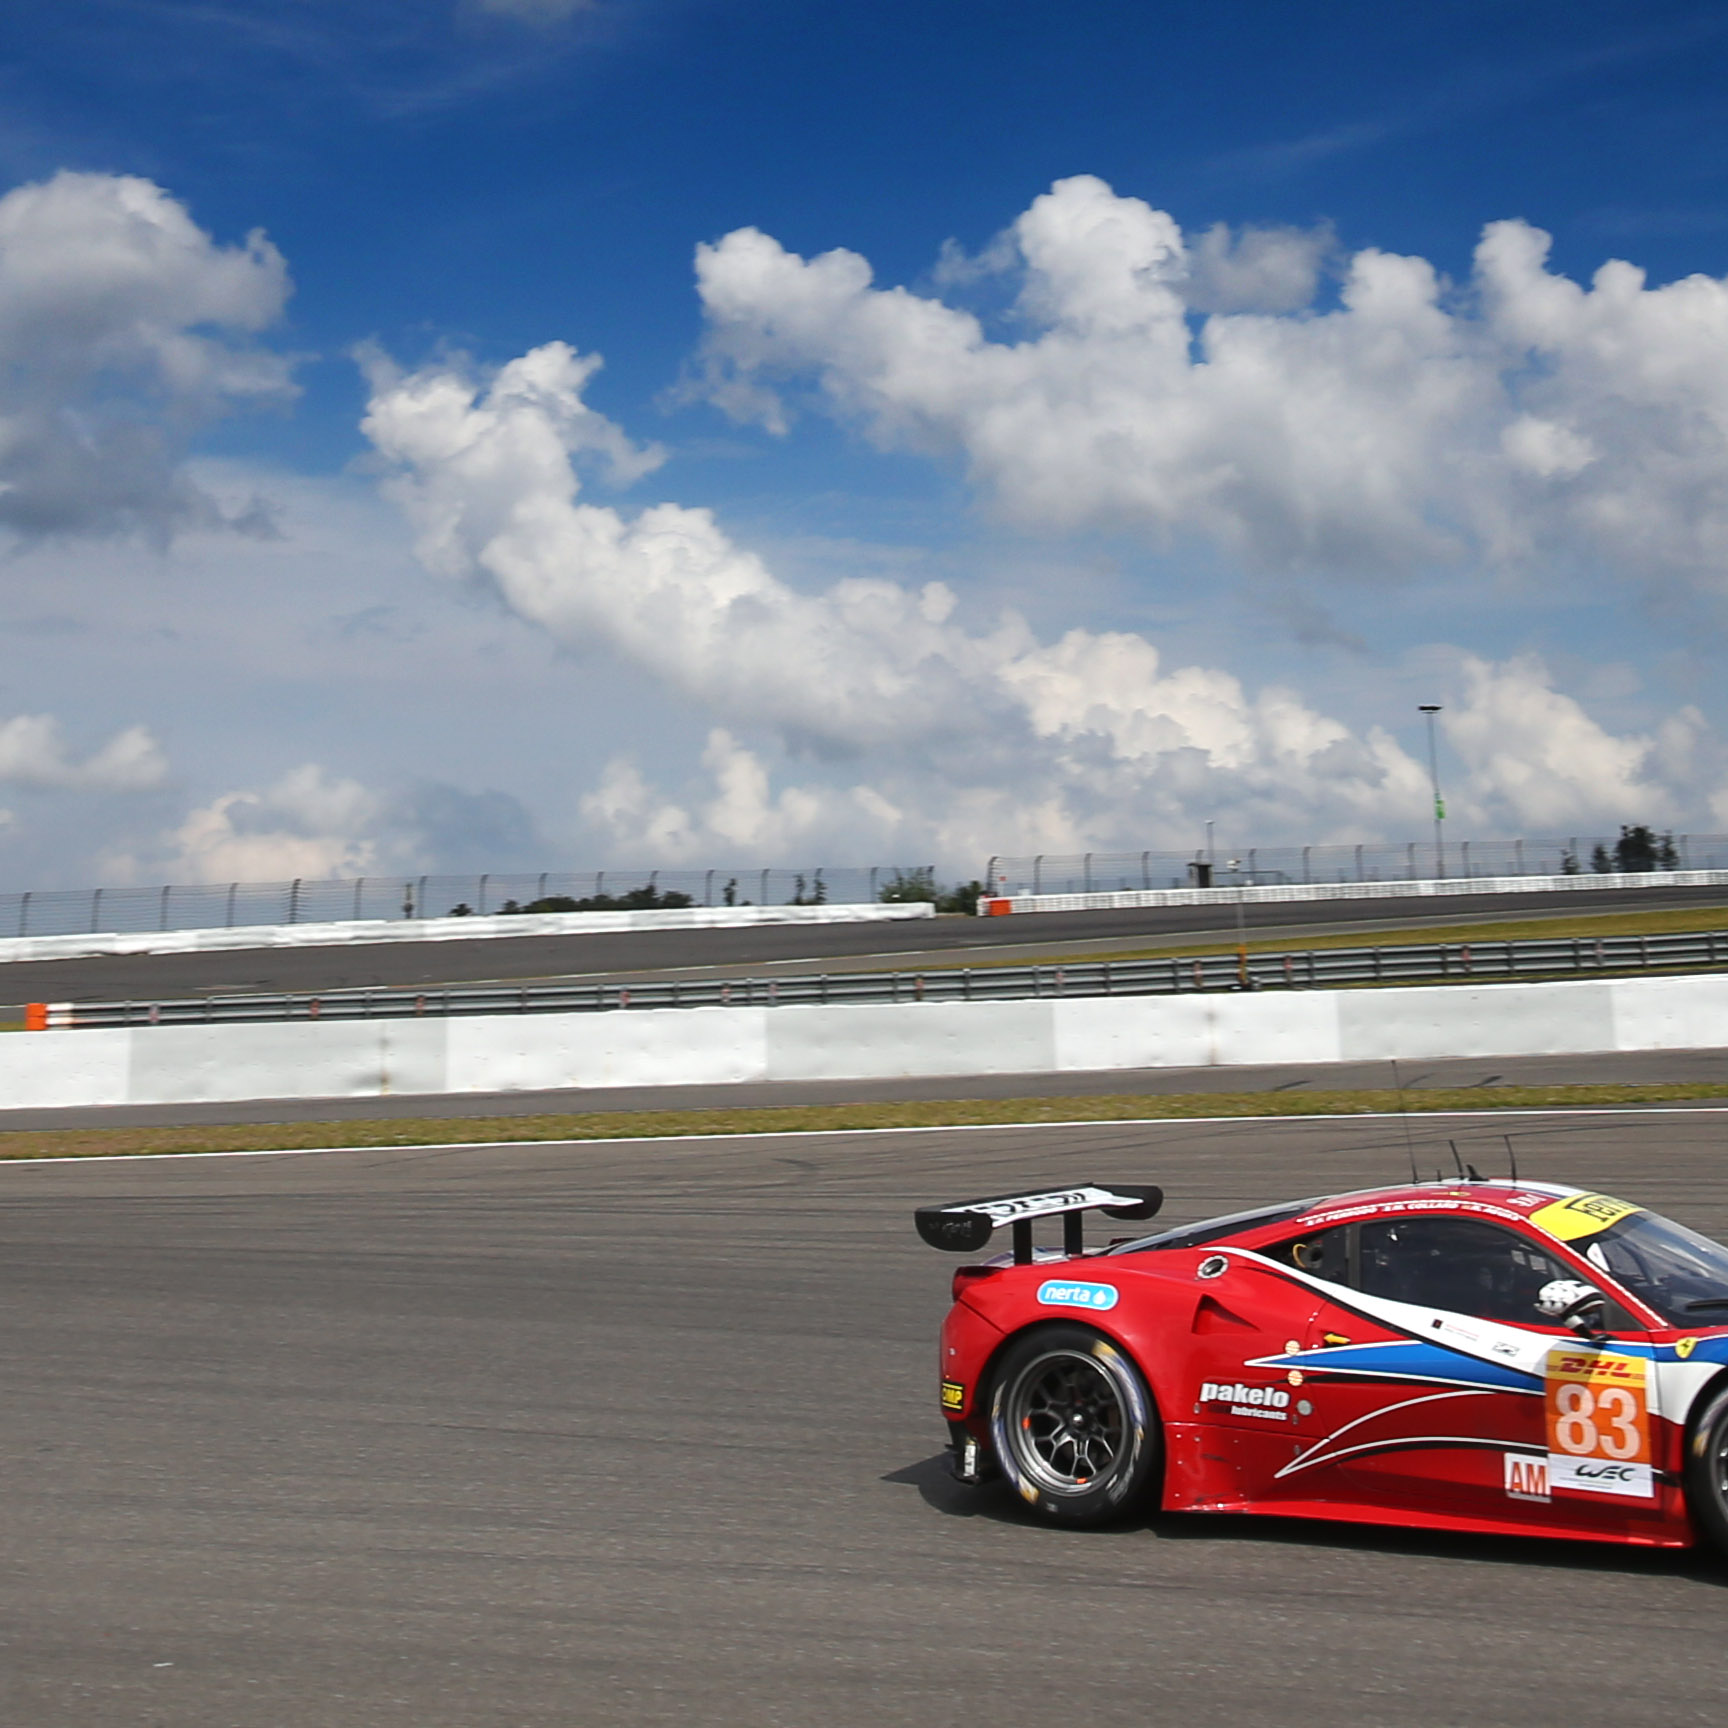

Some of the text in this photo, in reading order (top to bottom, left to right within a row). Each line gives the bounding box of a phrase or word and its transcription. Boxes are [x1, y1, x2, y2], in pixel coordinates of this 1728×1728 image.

[1044, 1285, 1091, 1303] nerta
[1560, 1357, 1632, 1378] DHL
[1199, 1382, 1291, 1408] pakelo
[1230, 1405, 1288, 1421] lubricants
[1554, 1383, 1641, 1460] 83
[1511, 1461, 1548, 1496] AM
[1574, 1463, 1636, 1482] WEC
